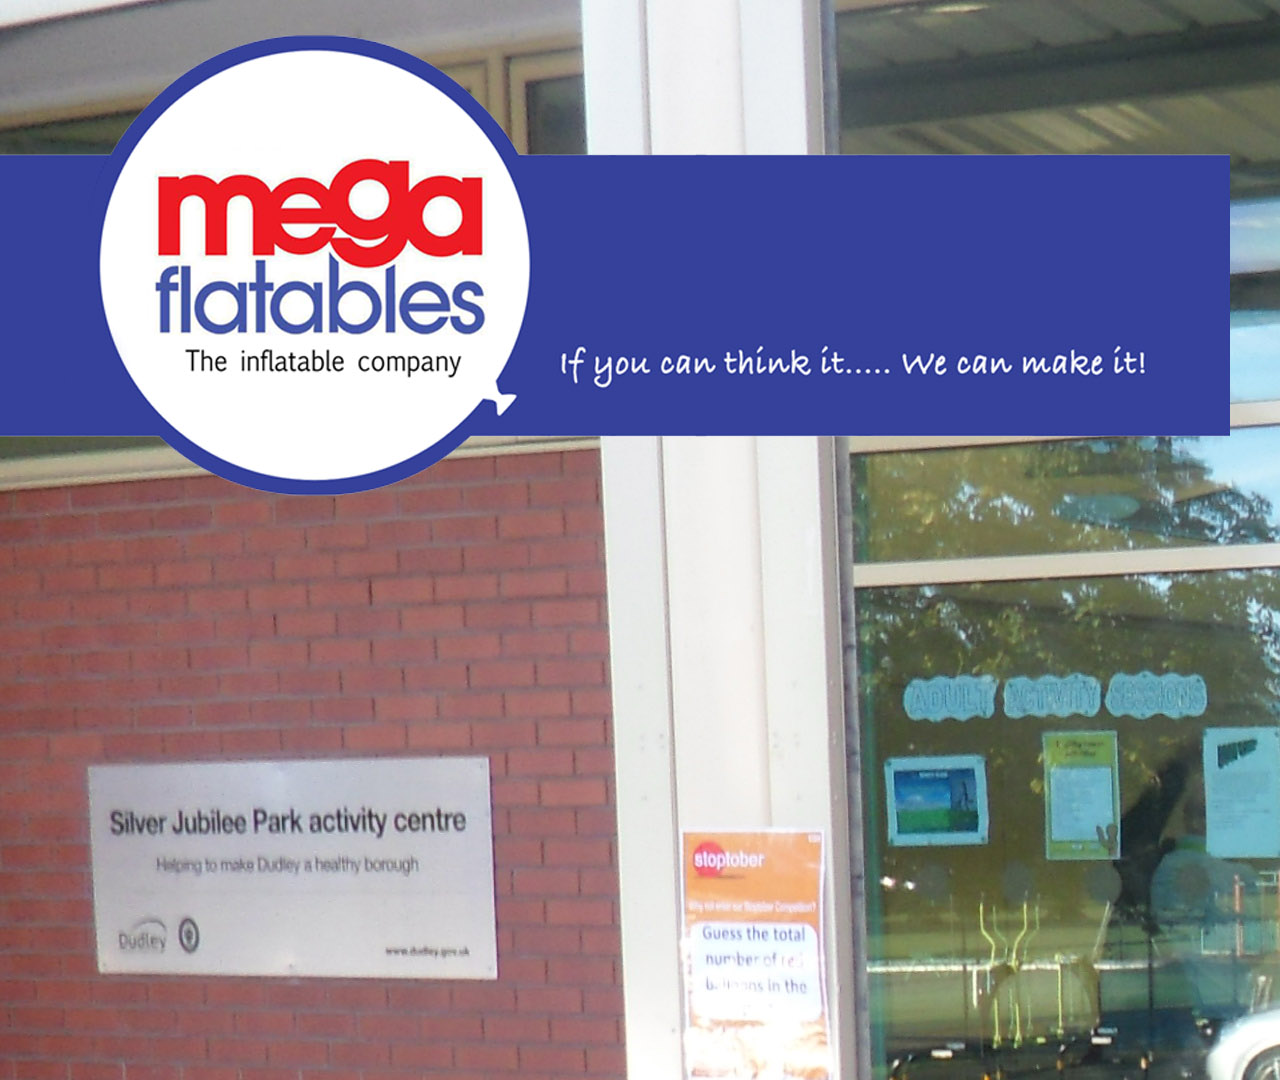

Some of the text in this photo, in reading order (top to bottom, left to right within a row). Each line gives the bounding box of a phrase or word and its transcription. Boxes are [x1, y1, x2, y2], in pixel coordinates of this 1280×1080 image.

[110, 806, 467, 839] Silver Jubilee Park activity centre
[156, 855, 420, 876] Helping to make Dudley a healthy borough
[694, 850, 766, 871] stoptober
[117, 930, 168, 954] Dudley
[702, 925, 806, 942] Guess the total
[705, 950, 761, 967] number
[763, 951, 777, 967] of
[767, 977, 781, 993] in
[784, 978, 808, 995] the
